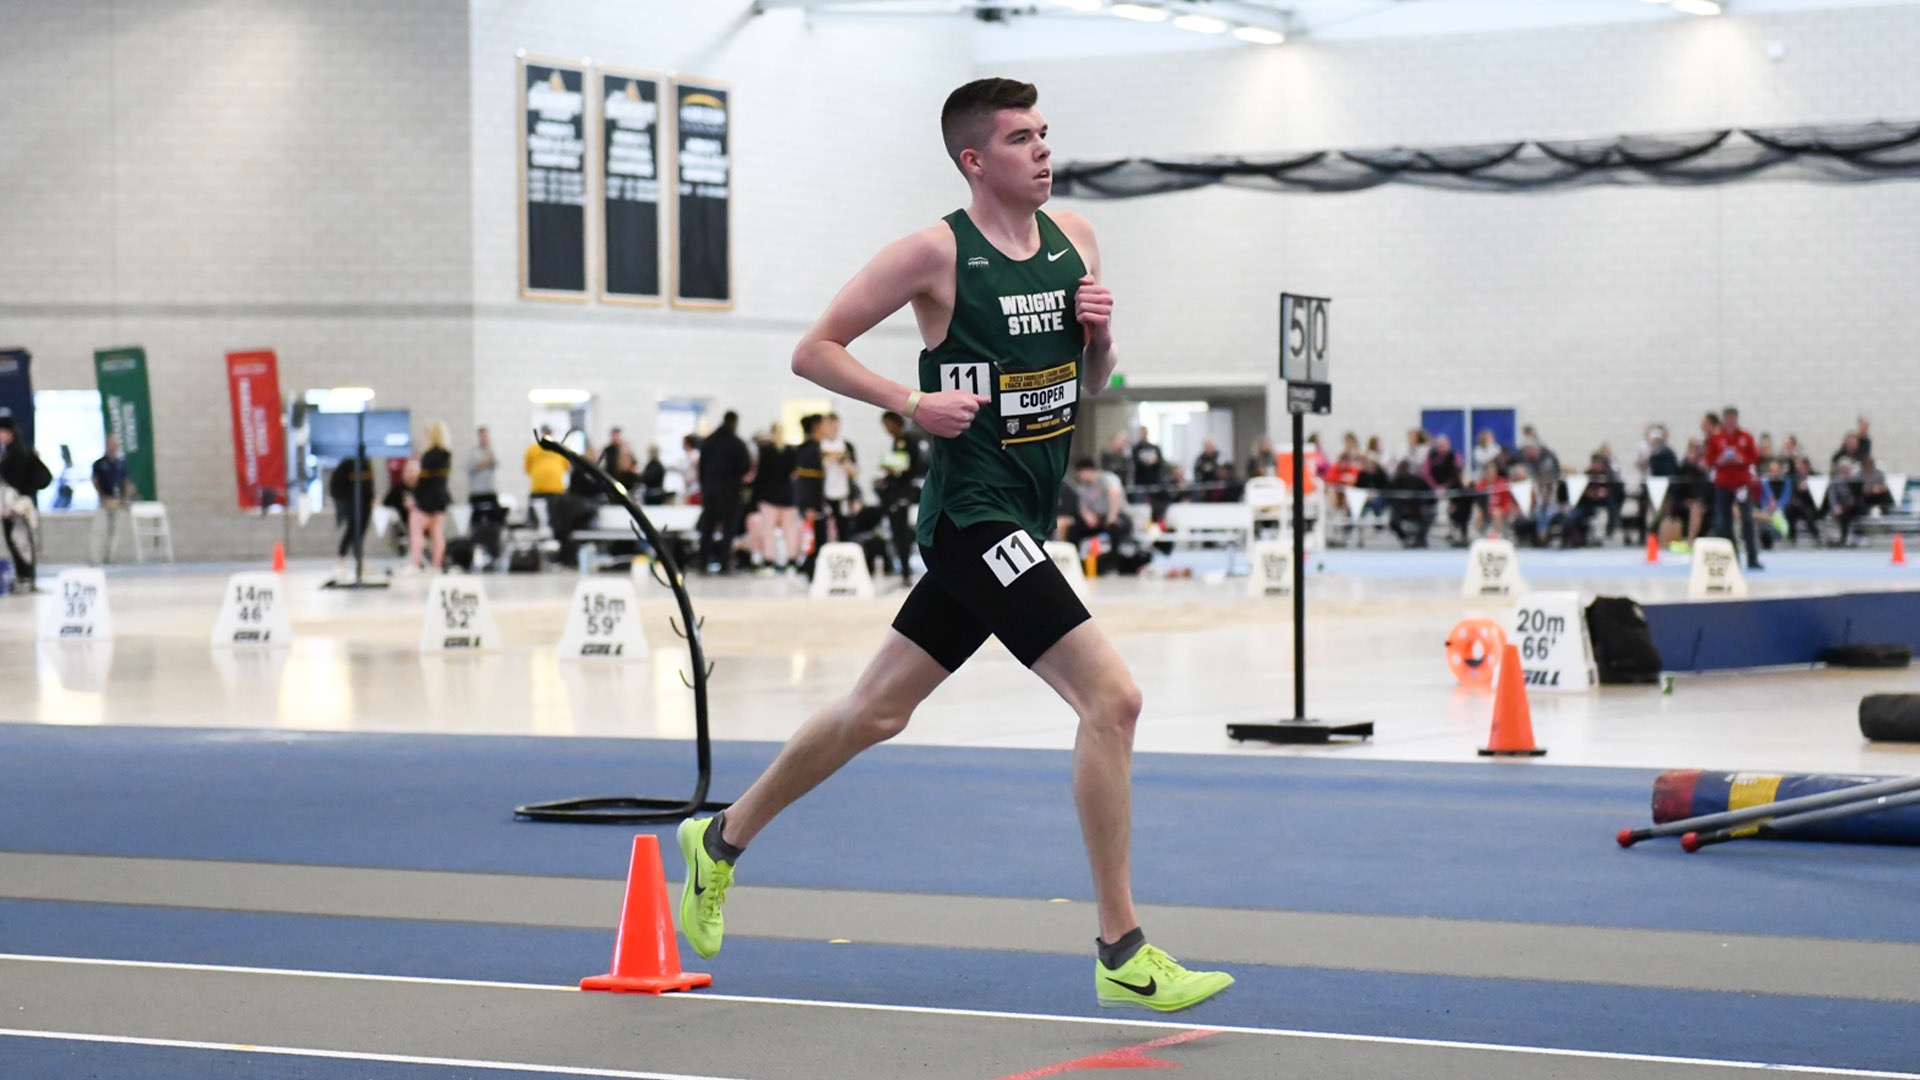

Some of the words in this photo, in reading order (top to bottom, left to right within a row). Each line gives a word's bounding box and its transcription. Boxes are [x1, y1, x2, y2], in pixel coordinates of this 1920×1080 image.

[998, 289, 1066, 315] WRIGHT
[1008, 312, 1064, 336] STATE
[1290, 298, 1327, 361] 50
[949, 366, 979, 394] 11
[1020, 386, 1064, 408] COOPER
[995, 534, 1036, 575] 11
[64, 580, 97, 599] 12m
[236, 585, 273, 602] 14m
[441, 588, 479, 608] 16m
[583, 593, 626, 613] 18m
[1516, 608, 1565, 633] 20m
[1523, 636, 1556, 660] 66'
